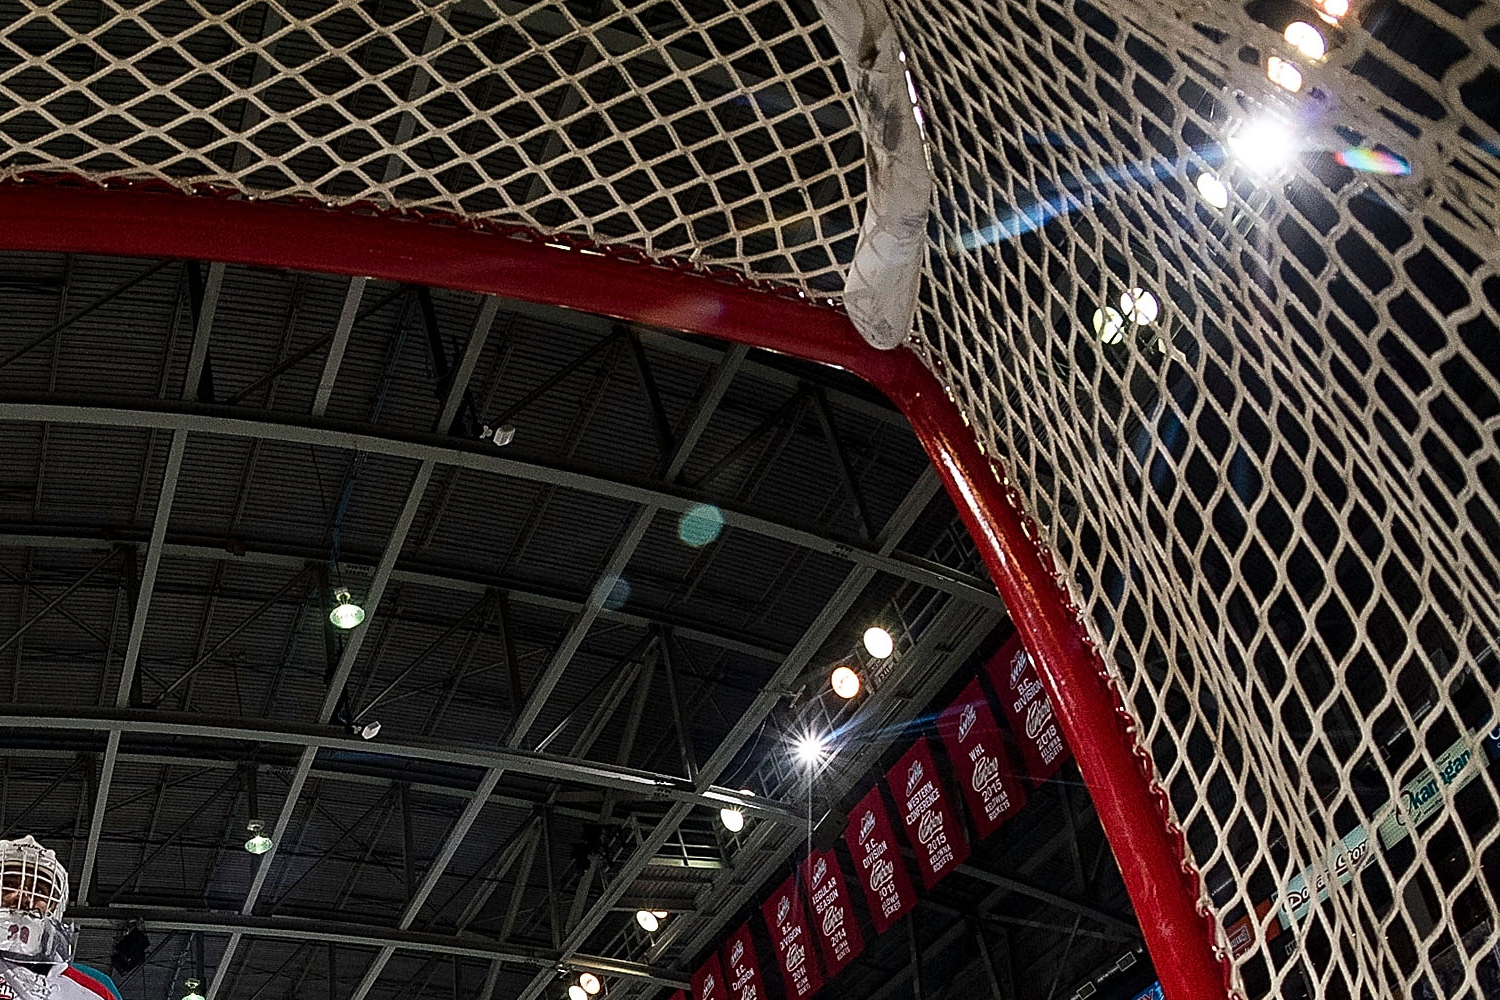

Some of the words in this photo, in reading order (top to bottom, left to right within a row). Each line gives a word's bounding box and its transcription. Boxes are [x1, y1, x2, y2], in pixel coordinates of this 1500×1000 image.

[1013, 681, 1043, 712] DIVISION
[969, 743, 985, 762] WHL
[906, 780, 934, 812] WESTERN
[981, 780, 1002, 803] 2015
[984, 791, 1008, 815] KELOWNA
[906, 787, 941, 826] CONFERENCE
[988, 799, 1010, 822] ROCKETS
[862, 840, 888, 869] DIVISION
[927, 832, 947, 856] 2015
[929, 843, 952, 866] KELOWNA
[932, 852, 954, 874] ROCKETS
[815, 888, 840, 914] SEASON
[779, 925, 802, 951] DIVISION
